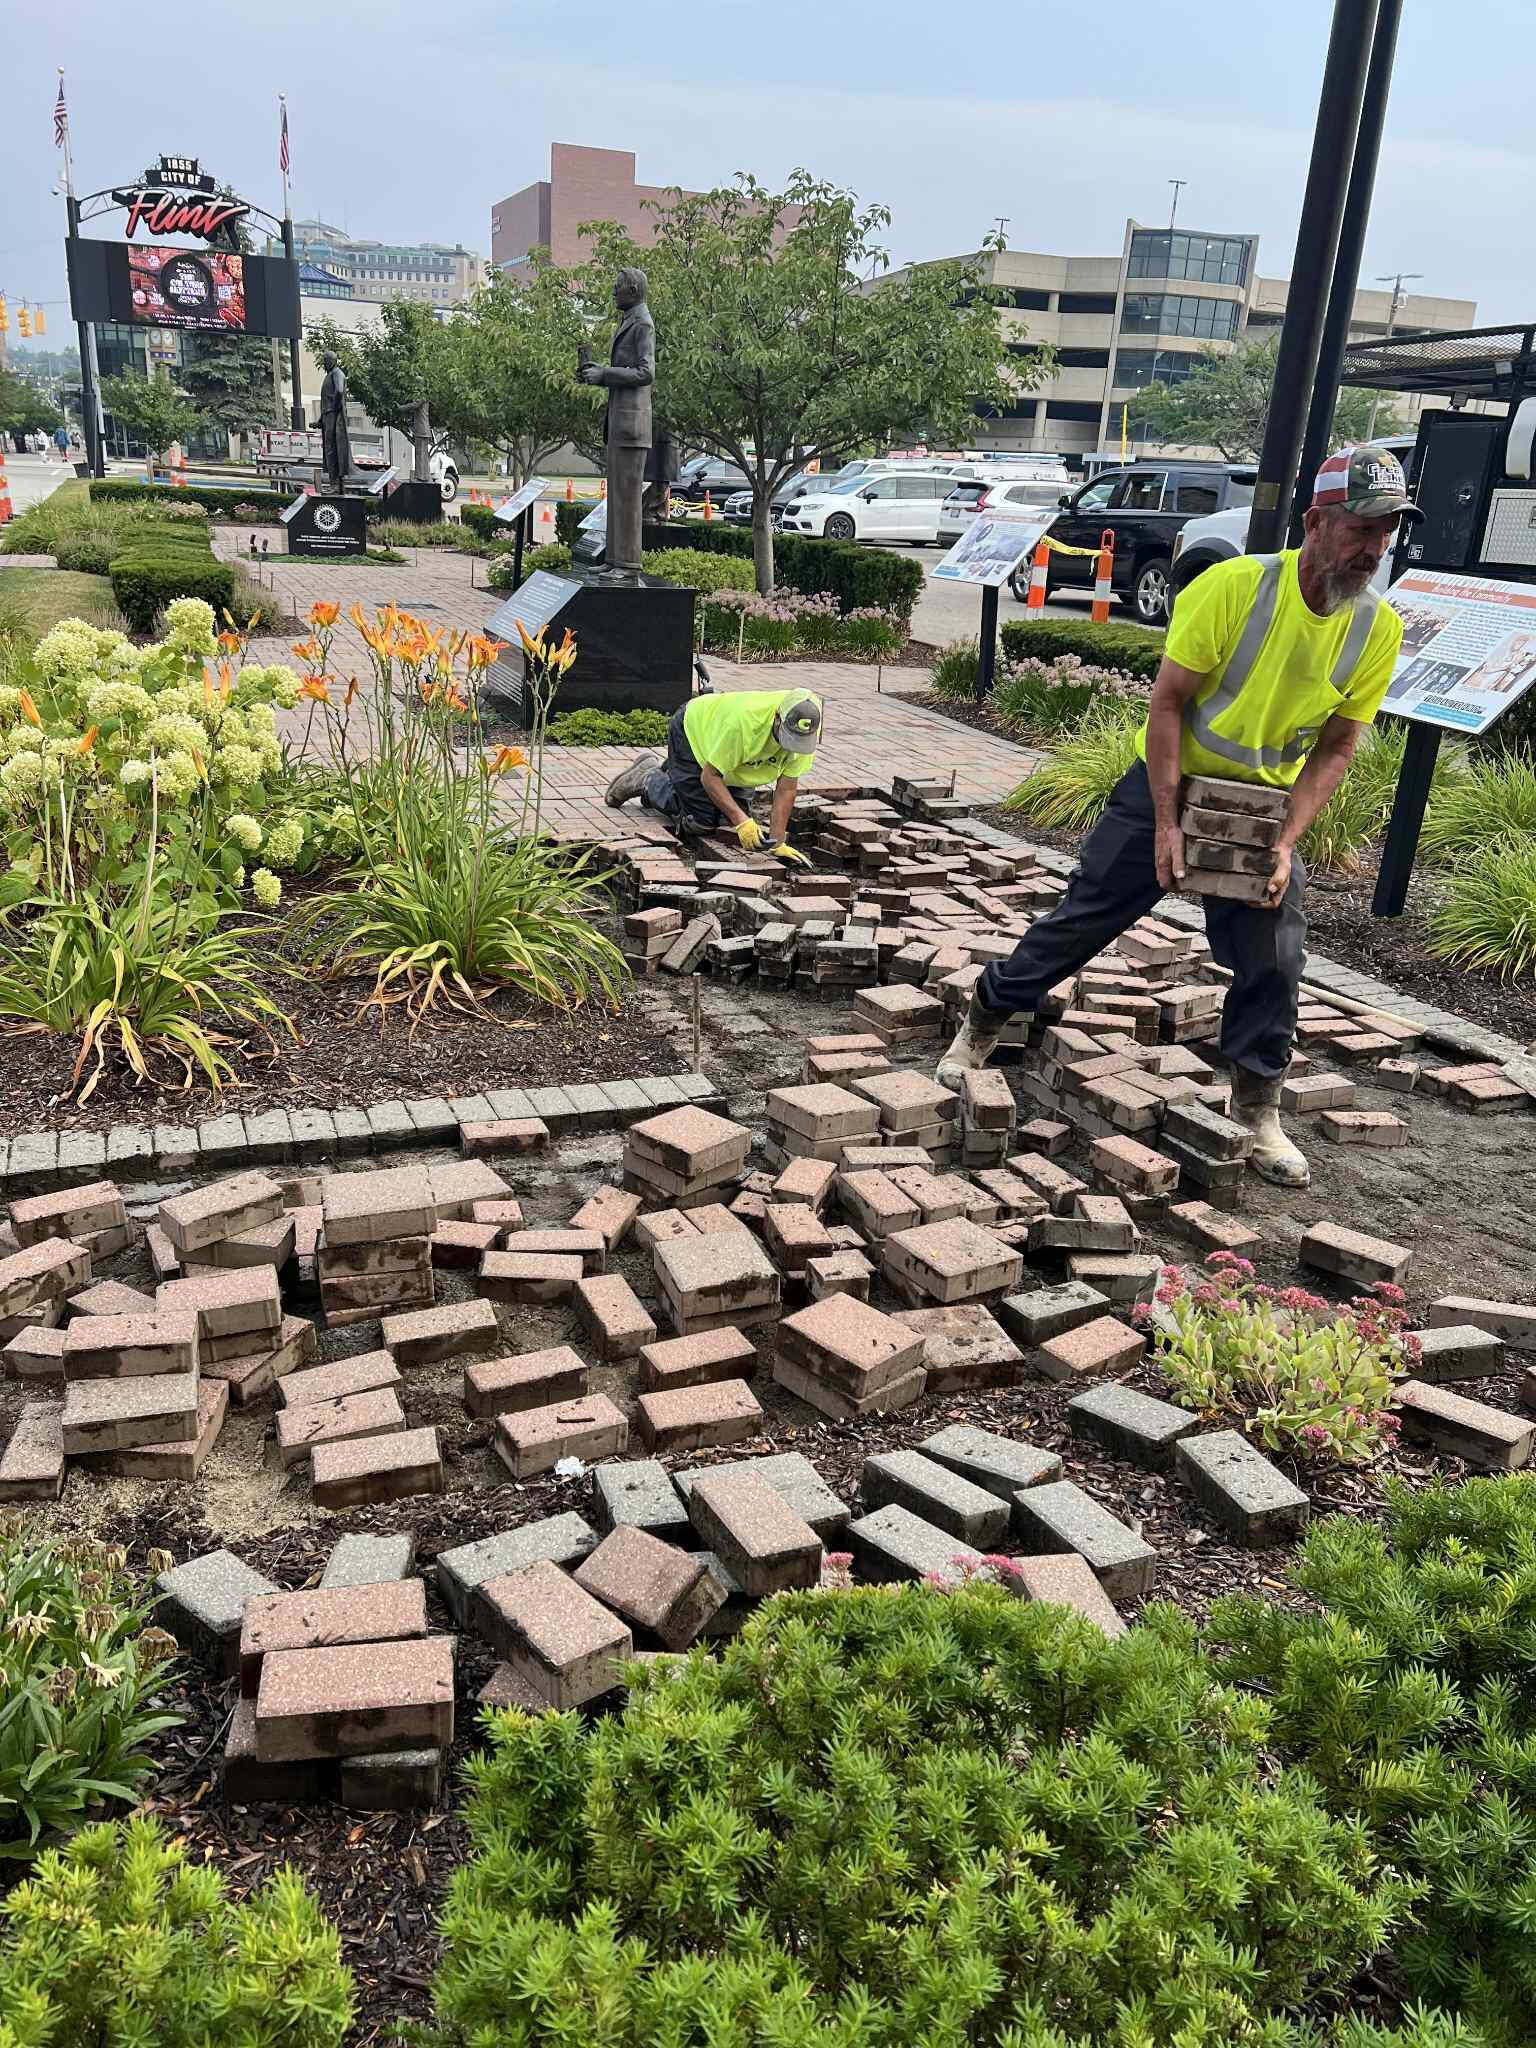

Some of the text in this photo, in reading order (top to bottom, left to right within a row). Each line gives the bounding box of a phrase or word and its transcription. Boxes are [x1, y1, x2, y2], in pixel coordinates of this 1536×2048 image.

[166, 158, 193, 171] 1855
[160, 171, 201, 185] CITY OF
[127, 190, 249, 237] Flint
